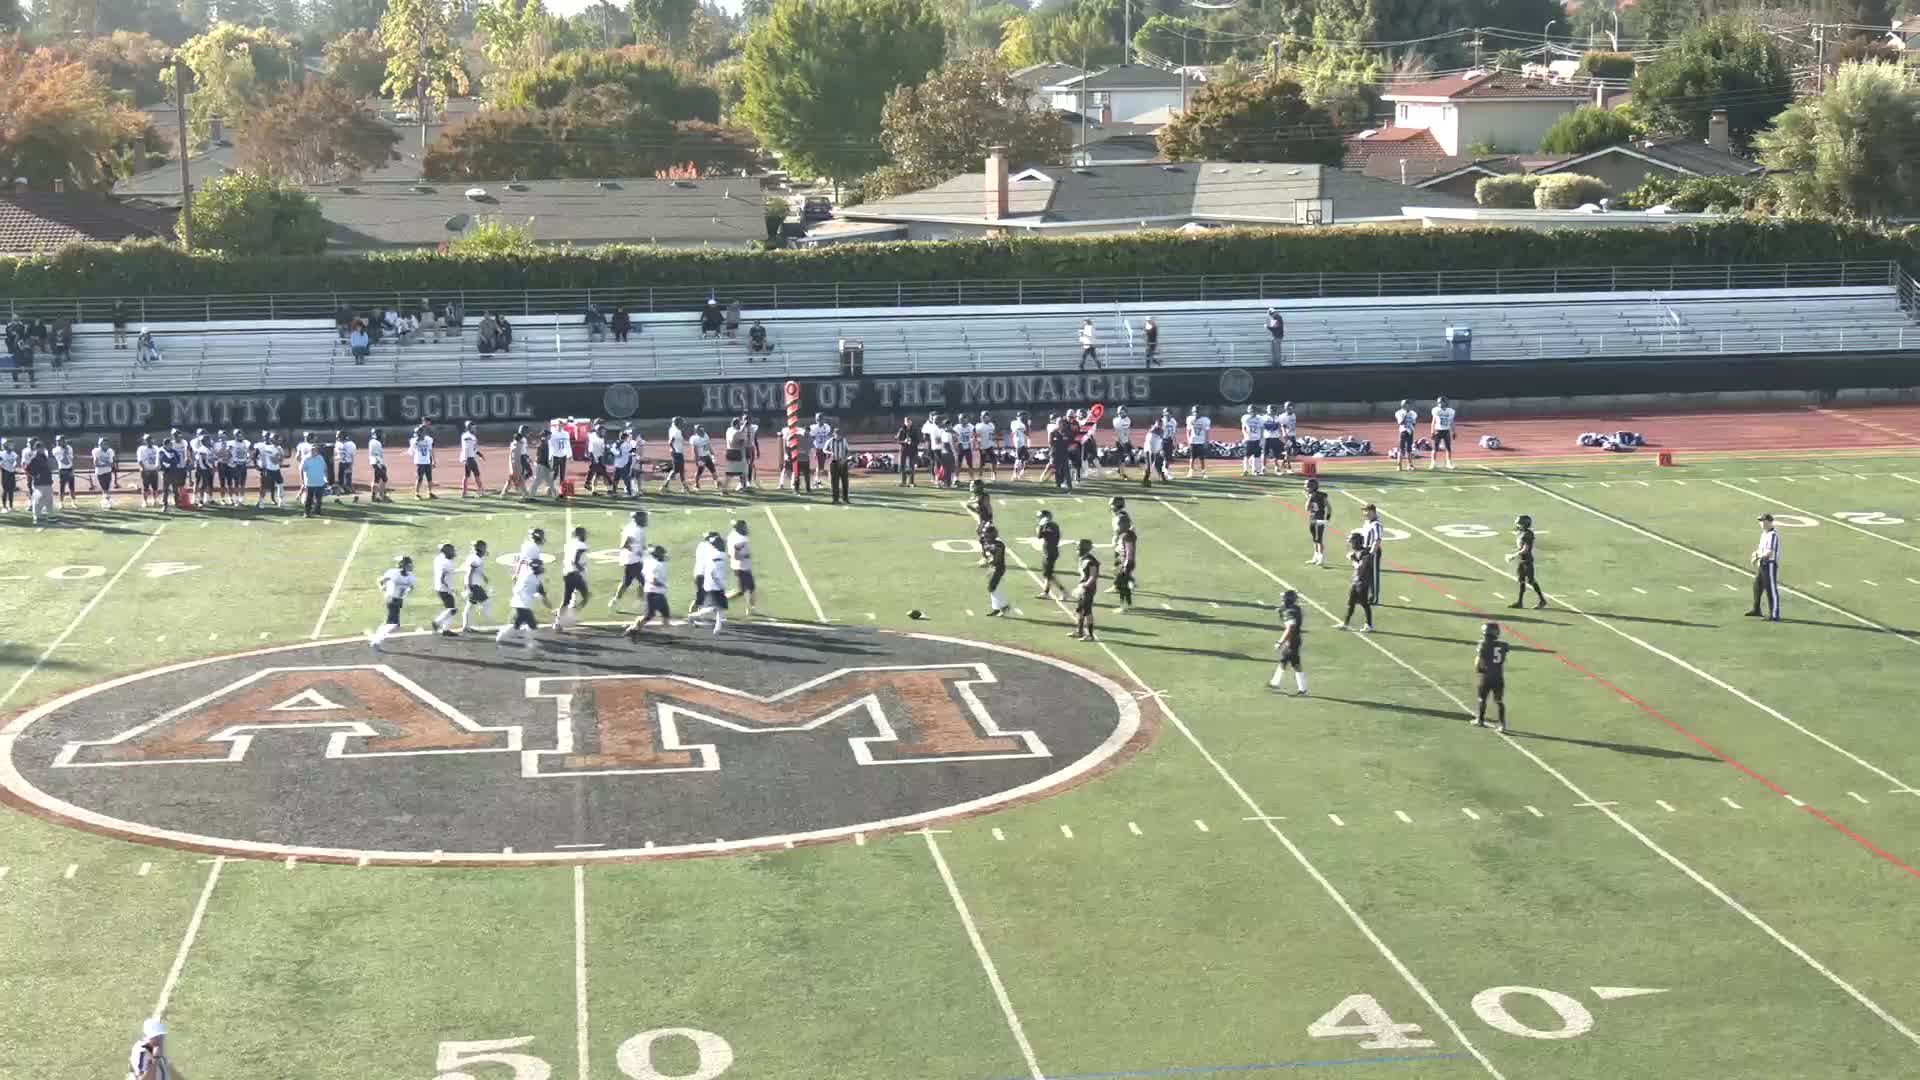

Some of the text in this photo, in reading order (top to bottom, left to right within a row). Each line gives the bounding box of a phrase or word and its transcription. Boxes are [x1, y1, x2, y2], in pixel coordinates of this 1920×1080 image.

[170, 395, 284, 425] MITTY
[302, 394, 384, 422] HIGH
[400, 388, 535, 420] SCHOOL
[702, 375, 1152, 410] HOM OF THE MONARCHS
